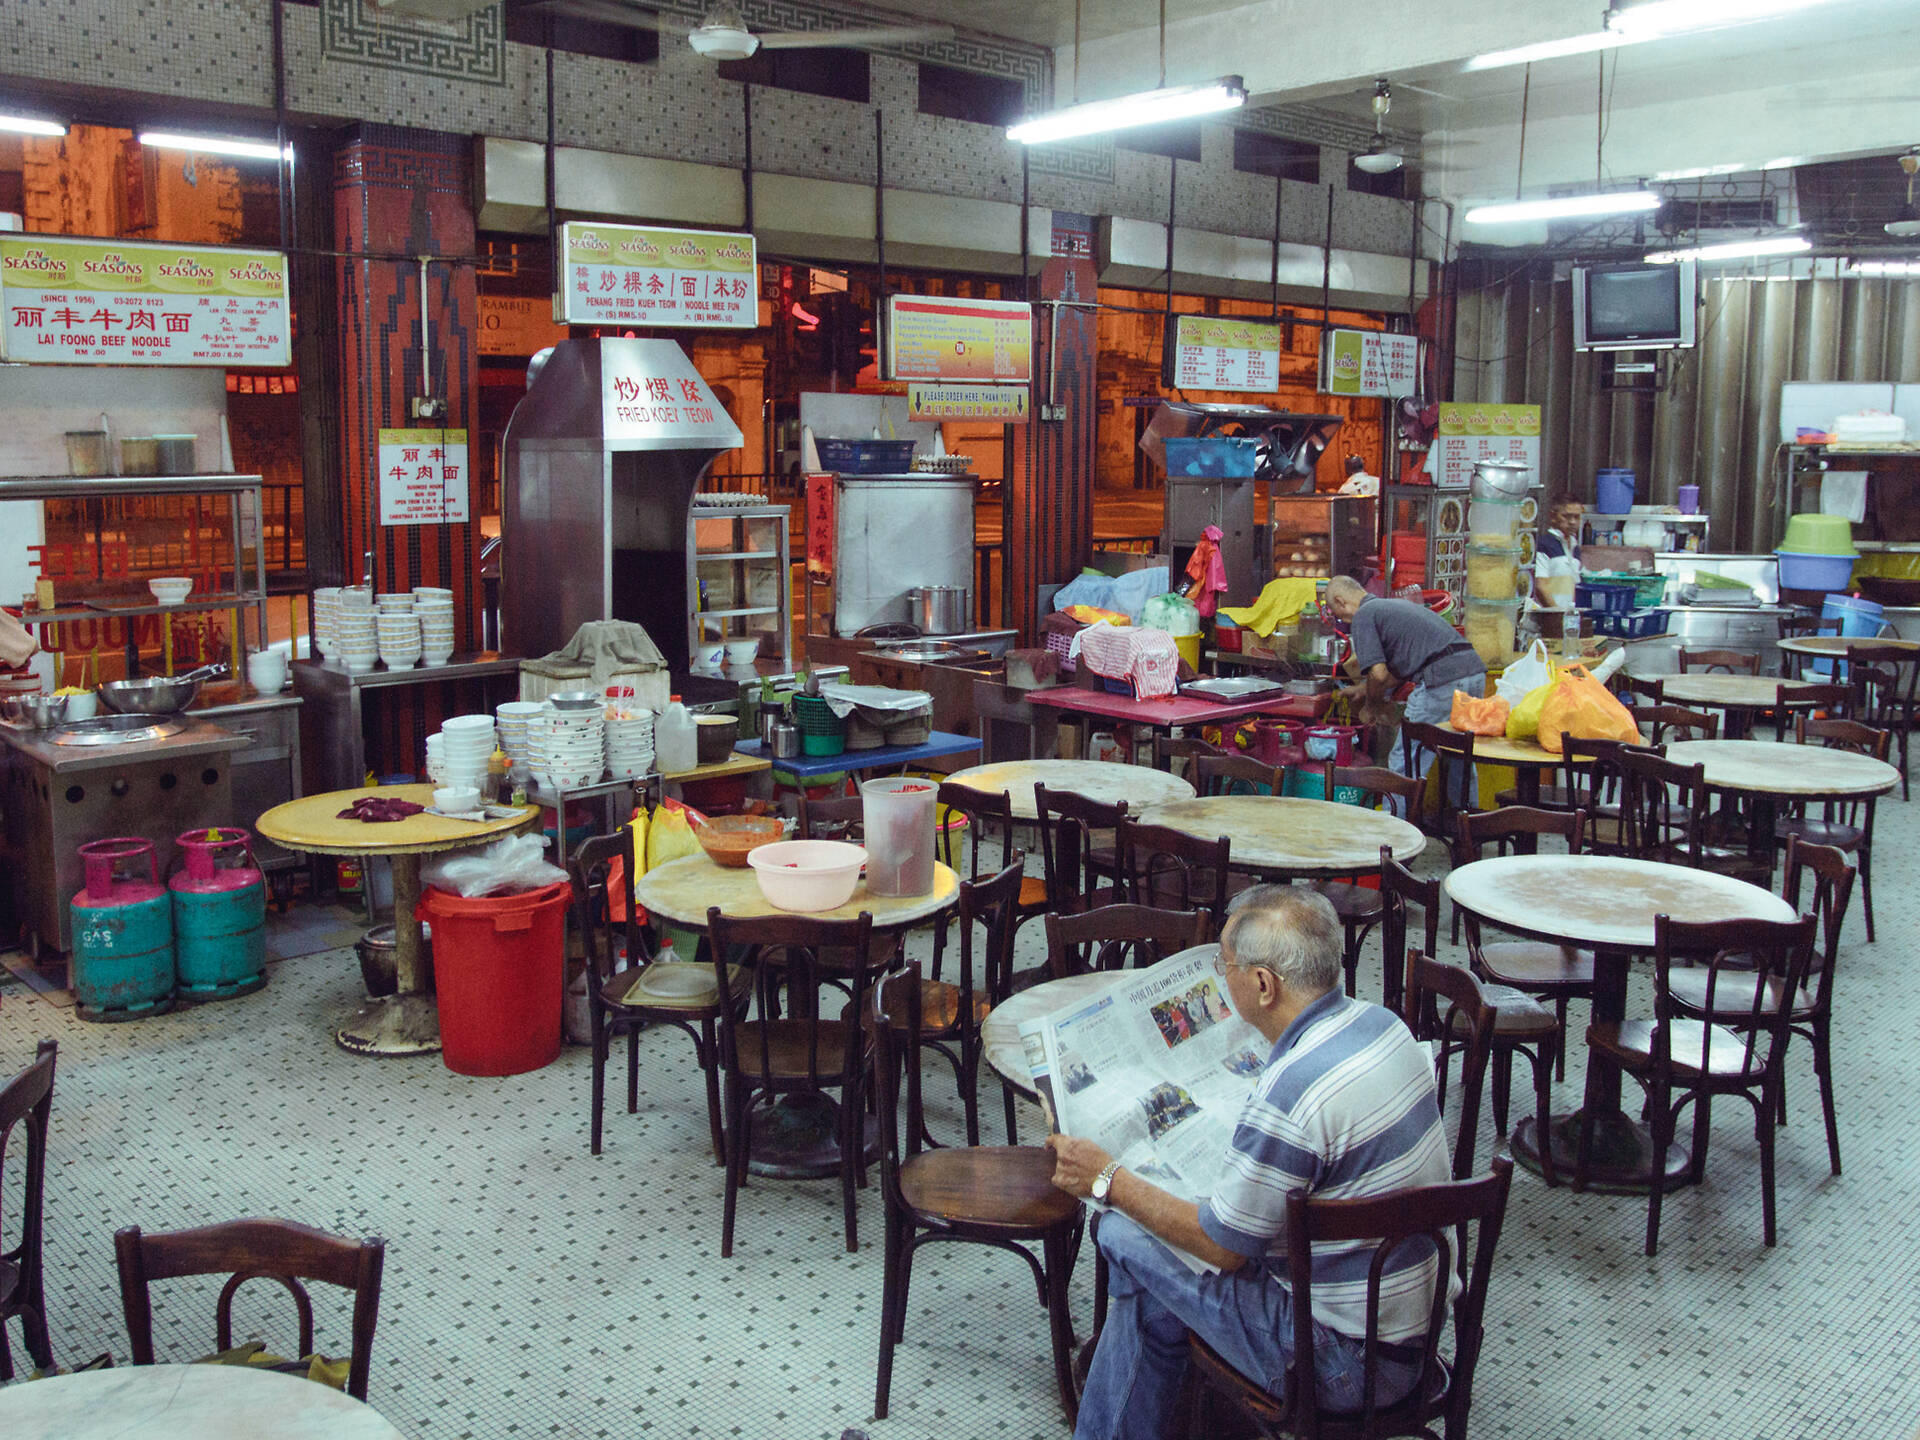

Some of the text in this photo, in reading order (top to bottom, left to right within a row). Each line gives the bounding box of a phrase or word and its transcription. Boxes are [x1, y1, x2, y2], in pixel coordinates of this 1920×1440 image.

[569, 238, 609, 249] SEASONS
[620, 242, 659, 253] SEASONS
[669, 245, 706, 256] SEASONS
[716, 248, 751, 259] SEASONS
[4, 256, 67, 271] SEASONS
[84, 260, 142, 274] SEASONS
[159, 264, 214, 278] SEASONS
[229, 267, 281, 281] SEASONS
[586, 296, 613, 307] PENANG
[616, 297, 634, 307] FRIED
[659, 299, 676, 309] TEOW
[685, 301, 709, 310] NOODLE
[712, 301, 725, 311] MEE
[11, 306, 192, 333] 丽丰牛肉面
[38, 333, 171, 347] LAI FOONG BEEF NOODLE
[924, 391, 944, 401] PLEASE
[946, 392, 963, 401] ORDER
[982, 392, 999, 402] THANK
[617, 406, 650, 423] FRIED
[683, 407, 714, 423] TEOW
[402, 448, 446, 462] 丽丰
[388, 465, 459, 480] 牛肉面
[1338, 790, 1358, 800] GAS
[82, 930, 112, 942] GAS
